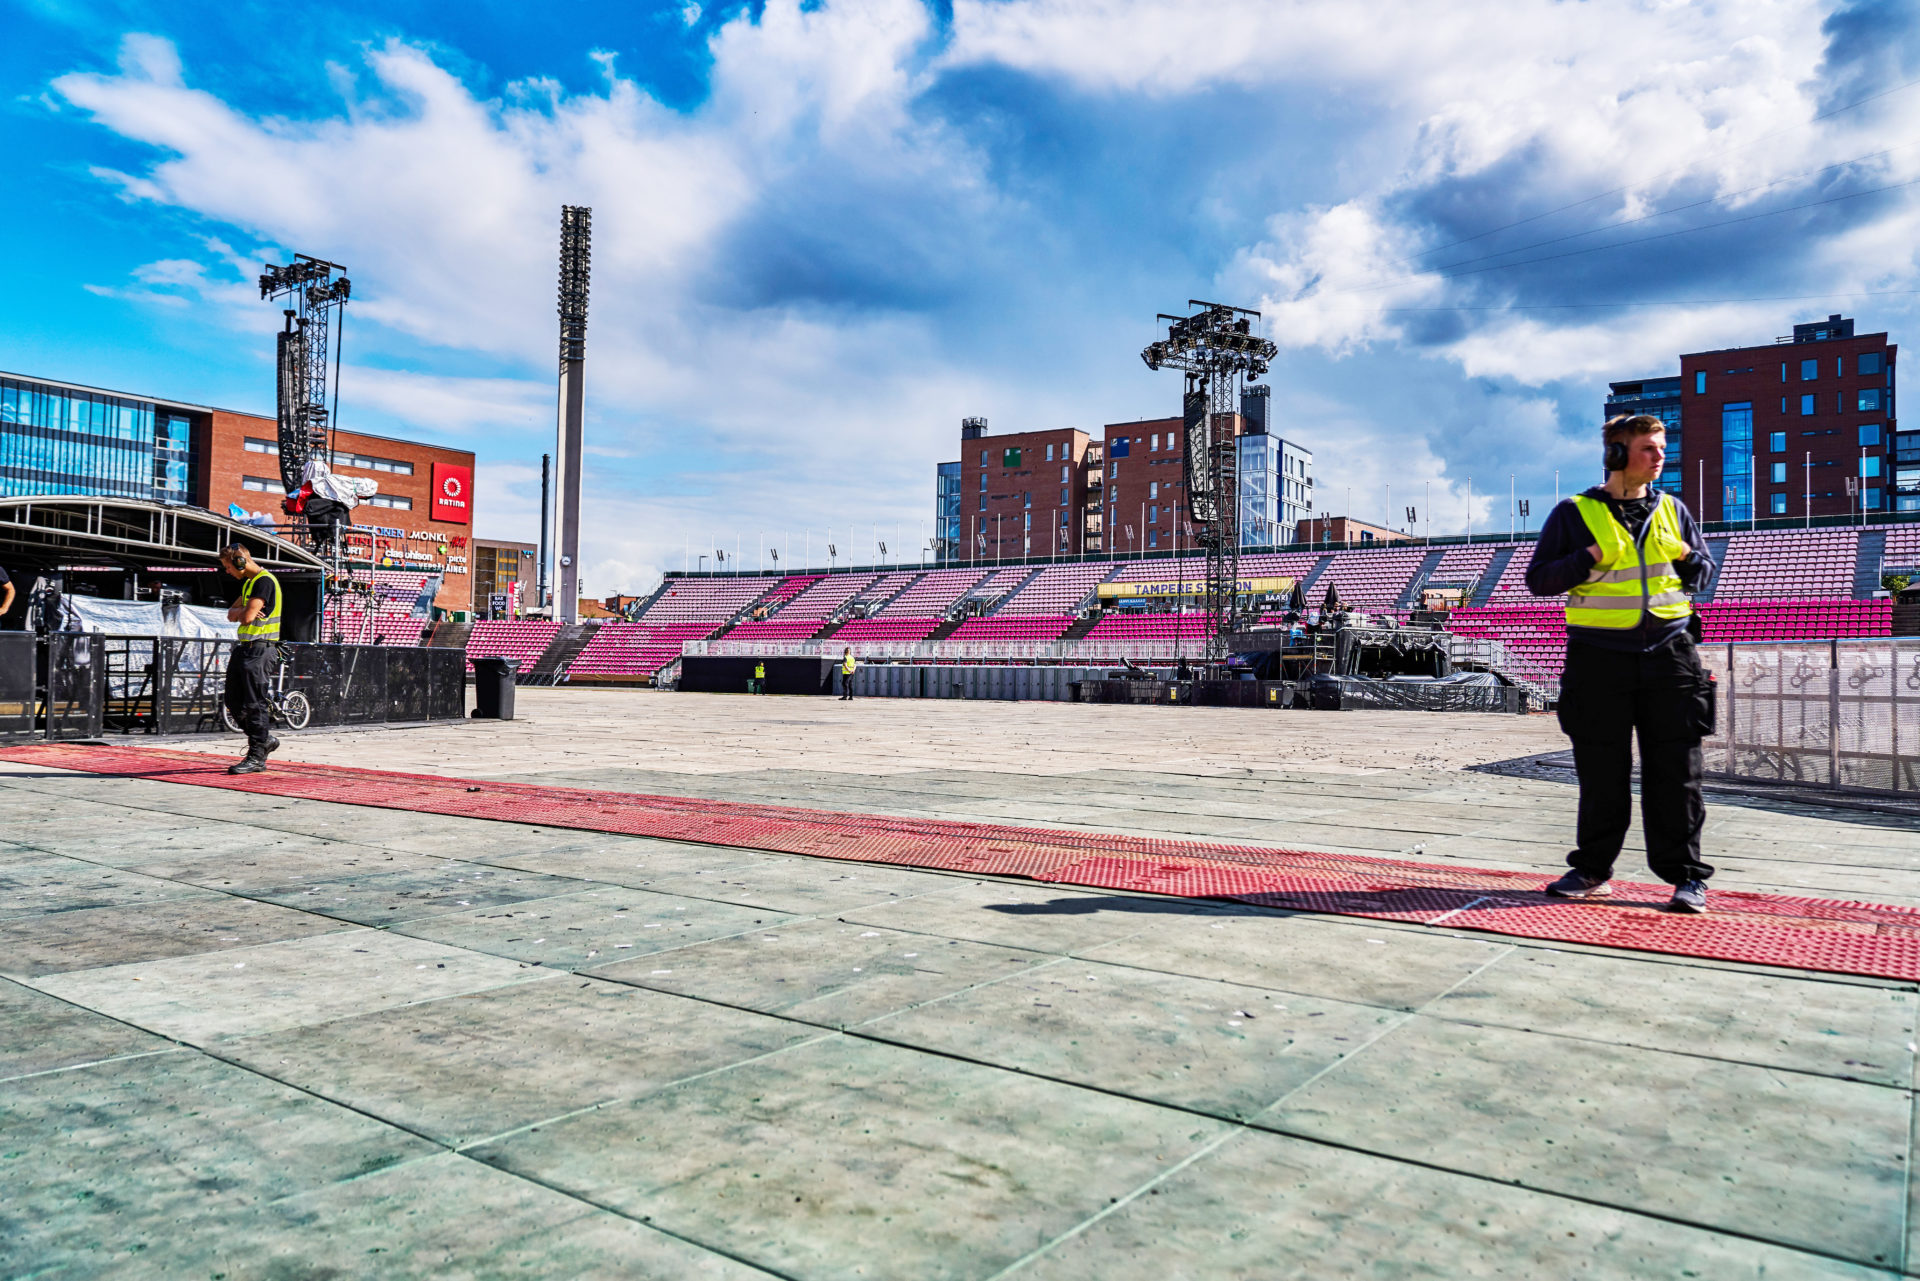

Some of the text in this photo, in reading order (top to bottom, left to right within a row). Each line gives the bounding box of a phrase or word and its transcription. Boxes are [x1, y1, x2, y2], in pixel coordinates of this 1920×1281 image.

[438, 498, 465, 508] RATINA
[1134, 580, 1252, 595] TAMPERE SADION
